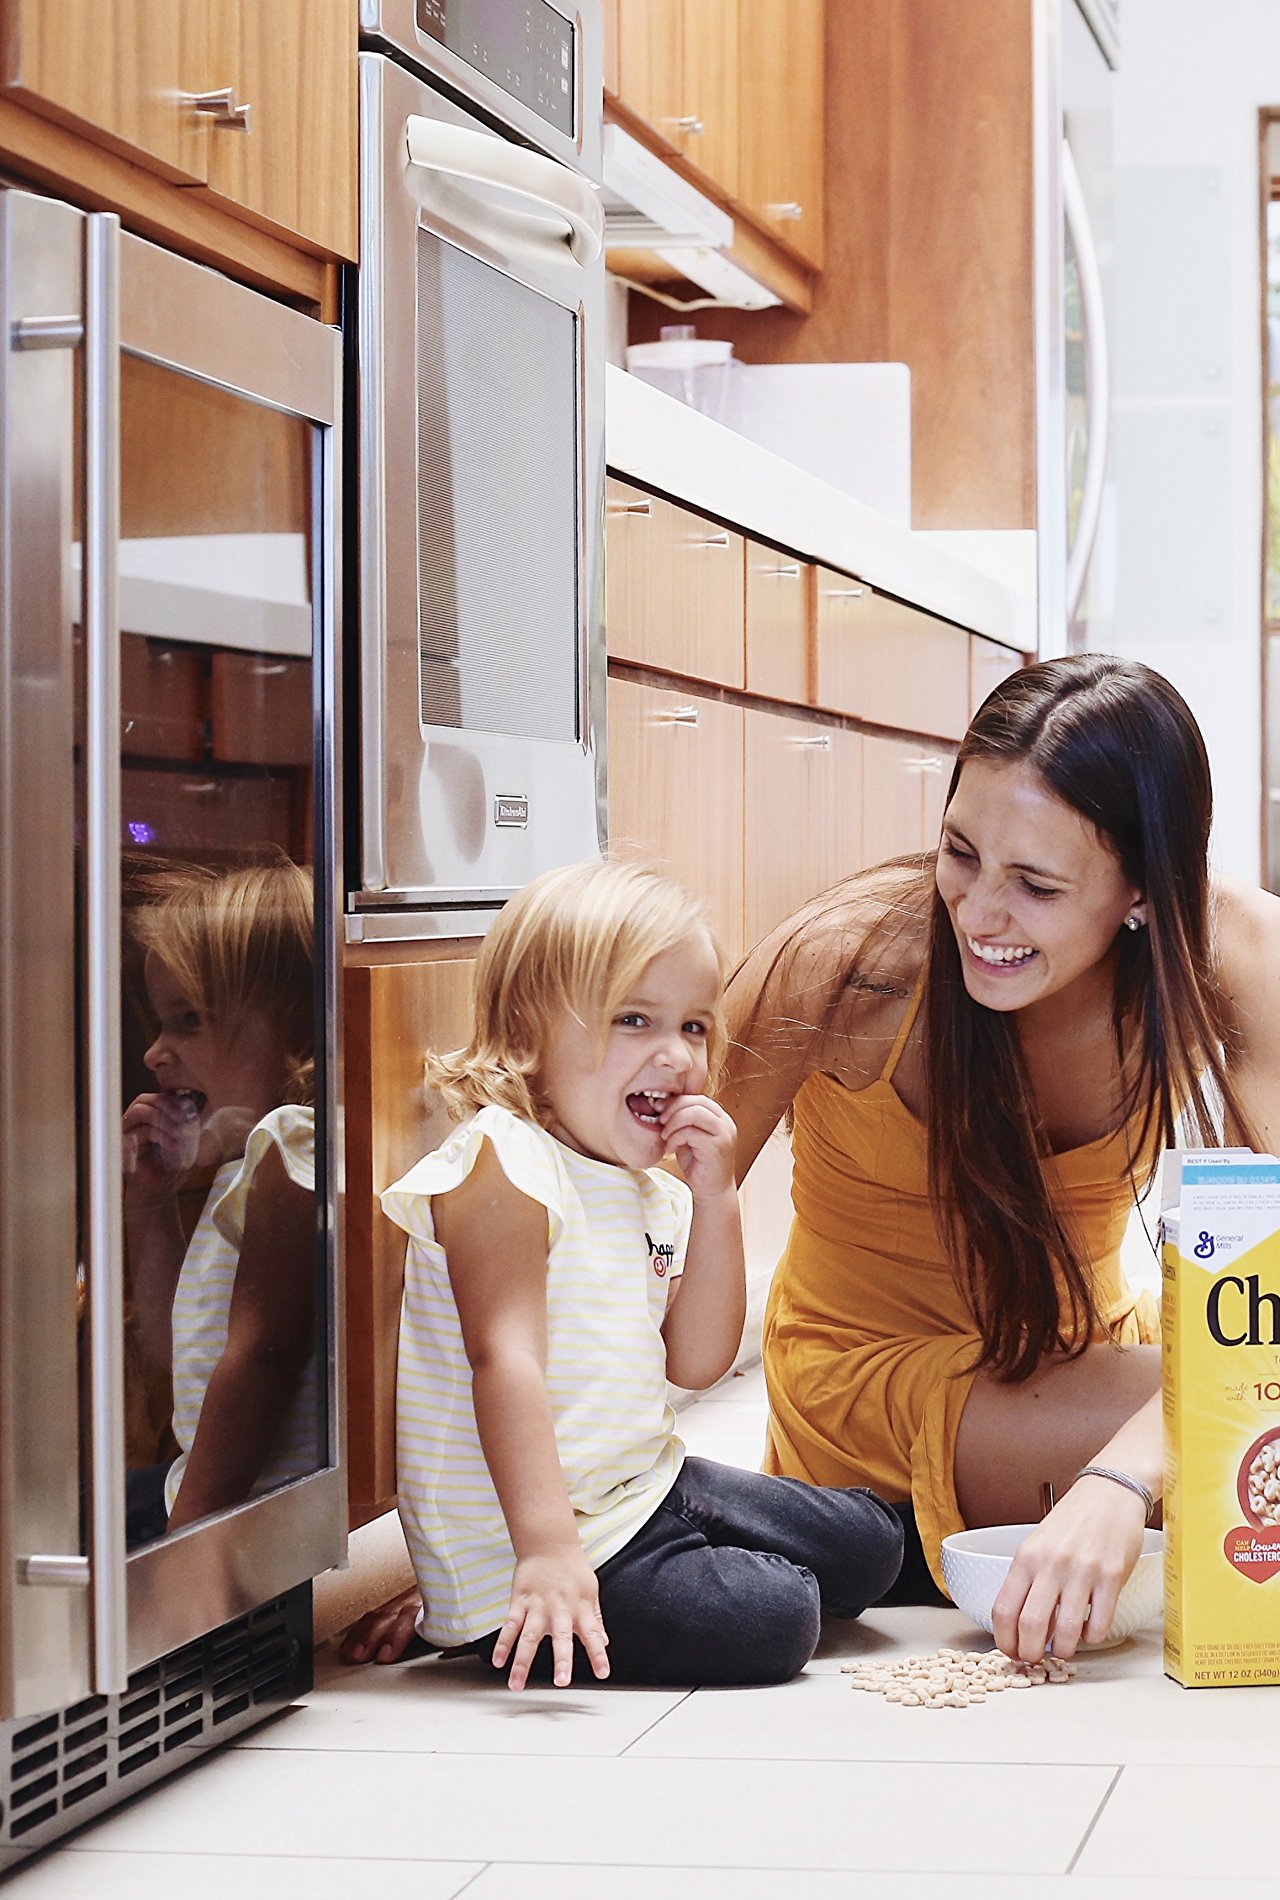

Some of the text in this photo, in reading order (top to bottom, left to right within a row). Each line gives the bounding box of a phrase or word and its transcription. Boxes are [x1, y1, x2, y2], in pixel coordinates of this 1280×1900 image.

[1215, 1234, 1244, 1242] General
[1194, 1668, 1280, 1680] NET WT 12 OZ (340g)
